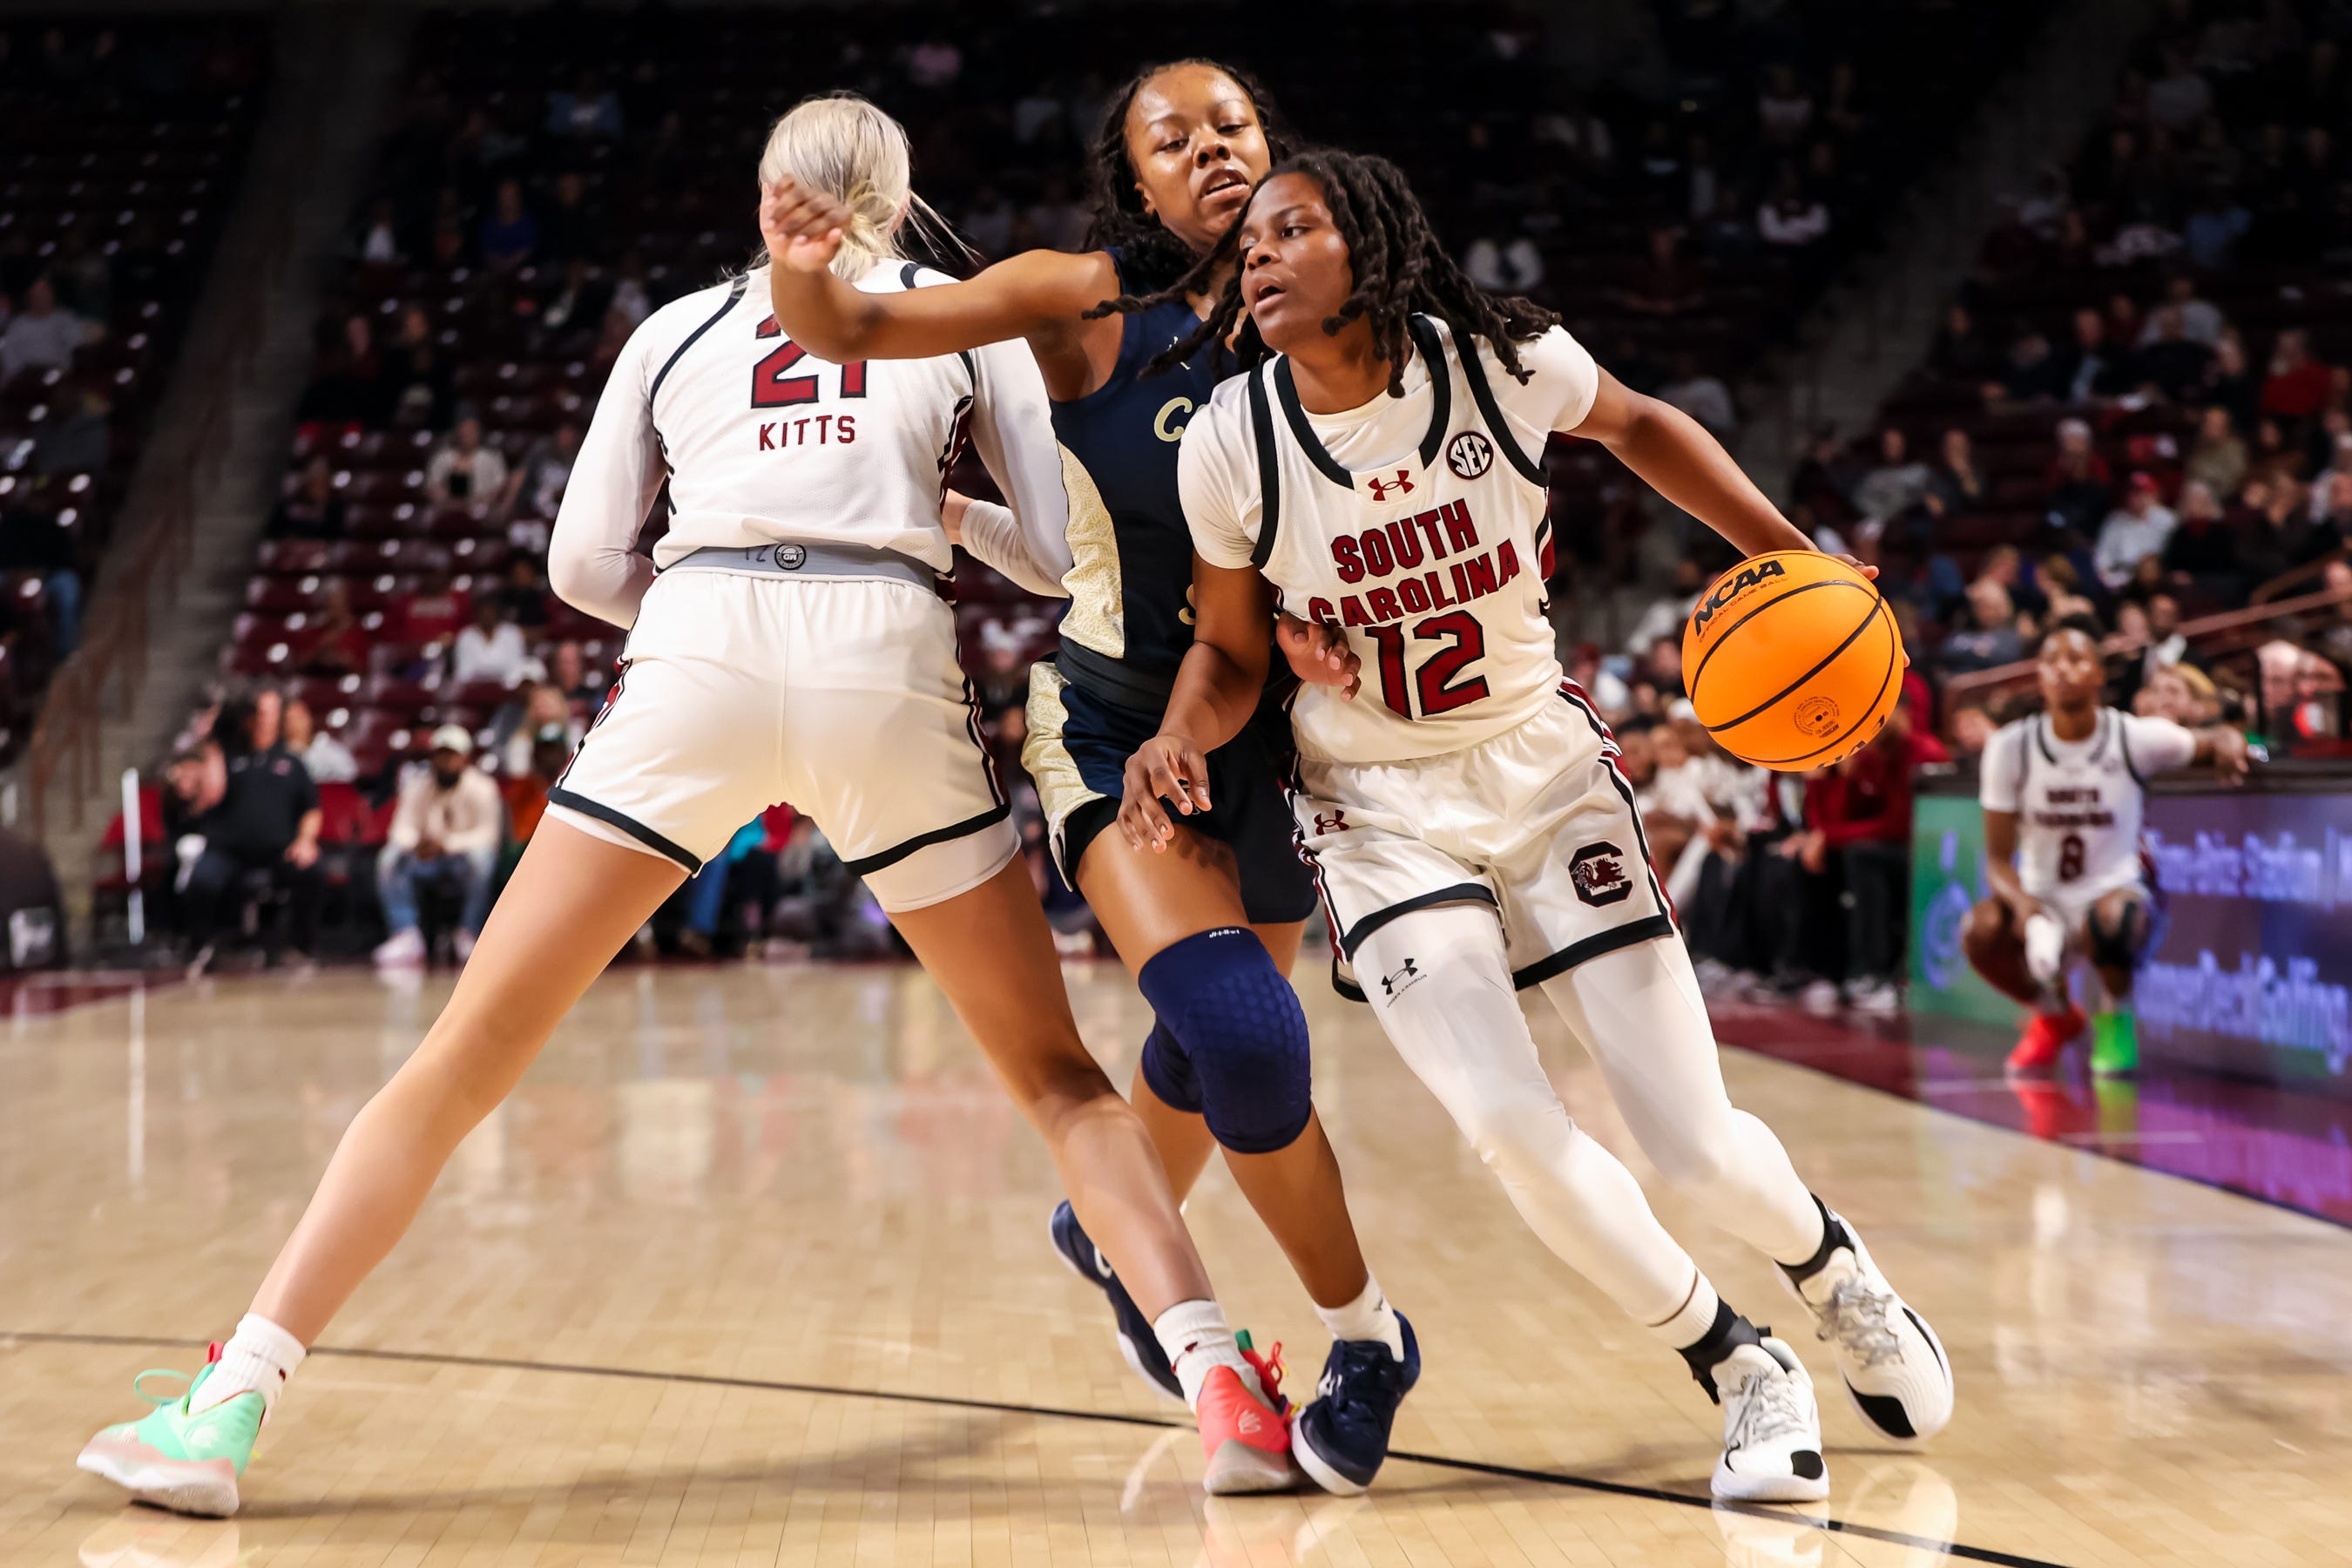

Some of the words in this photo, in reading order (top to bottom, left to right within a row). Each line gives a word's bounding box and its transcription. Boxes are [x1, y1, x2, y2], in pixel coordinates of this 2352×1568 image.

[759, 415, 855, 451] KITTS
[1450, 435, 1490, 476] SEC
[1330, 497, 1479, 584] SOUTH
[1308, 537, 1520, 627] CAROLINA
[1694, 560, 1785, 637] NCAA
[1730, 588, 1757, 606] GAME
[1760, 578, 1788, 589] BALL
[1365, 610, 1490, 721] 12
[2058, 834, 2085, 882] 8
